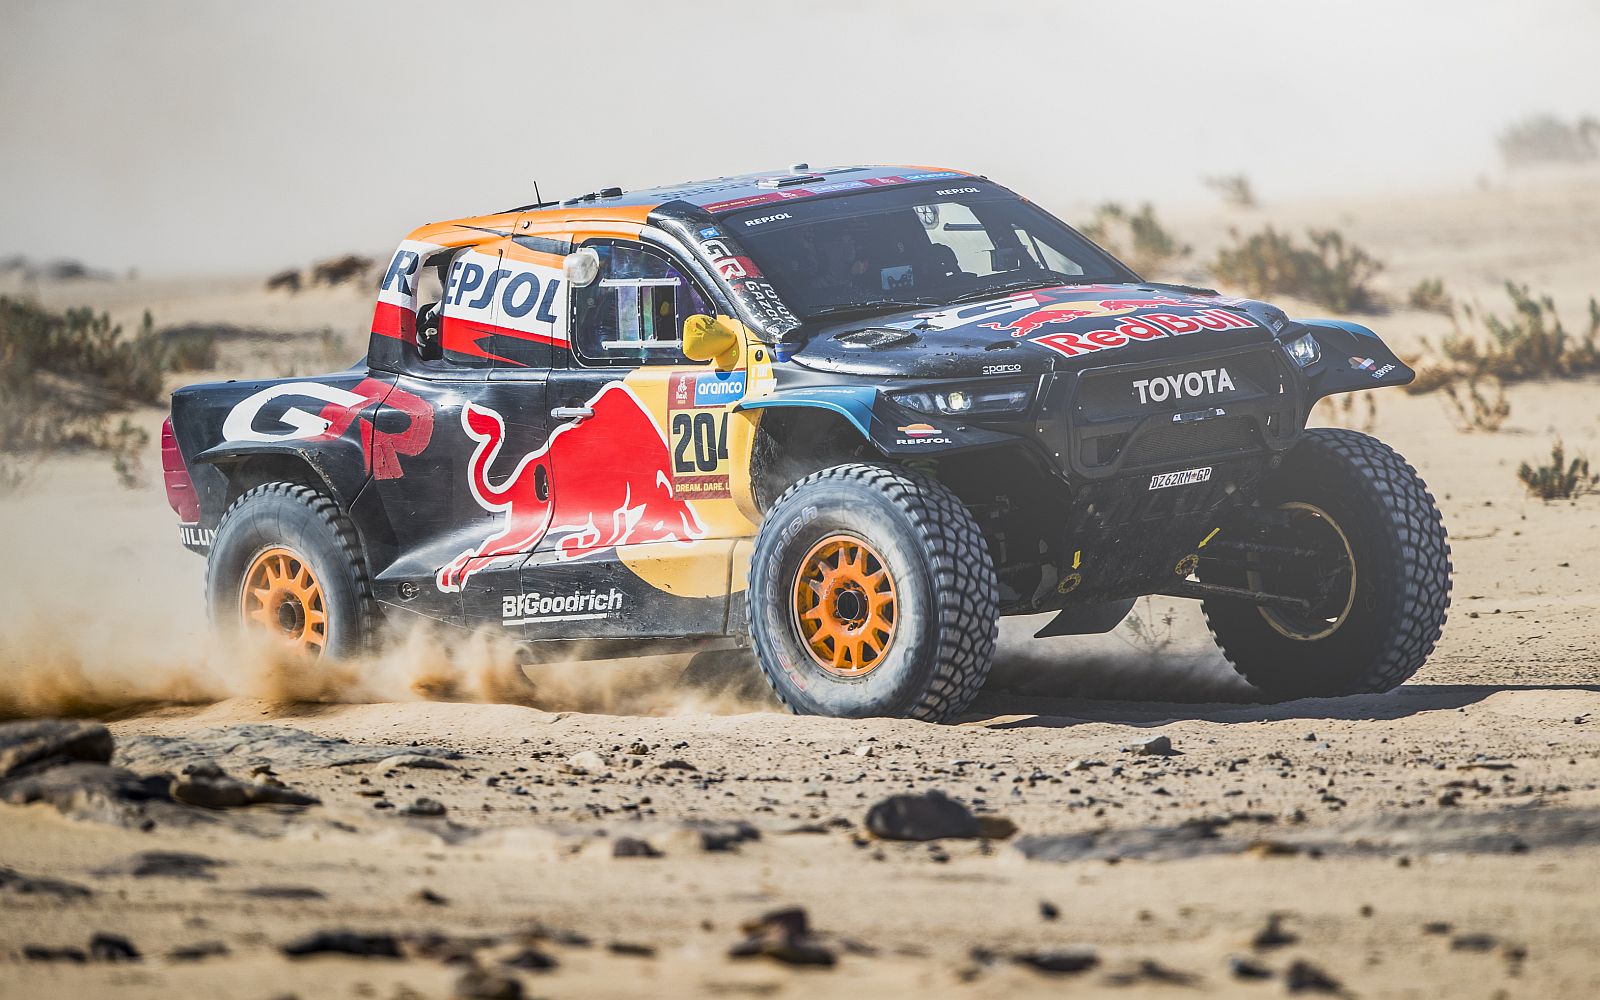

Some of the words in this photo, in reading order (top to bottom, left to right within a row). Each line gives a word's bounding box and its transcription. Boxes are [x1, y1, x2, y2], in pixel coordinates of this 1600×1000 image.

[935, 187, 980, 197] REPSOL
[744, 212, 793, 227] REPSOL
[1027, 315, 1170, 358] Red
[1141, 308, 1260, 336] Bull
[982, 363, 1022, 375] sparco
[698, 381, 742, 395] aramco
[1132, 367, 1236, 405] TOYOTA
[222, 377, 435, 481] GR
[896, 437, 953, 446] REPSOL
[675, 483, 702, 493] DREAM.
[703, 482, 725, 491] DARE.
[502, 588, 623, 618] BFGoodrich
